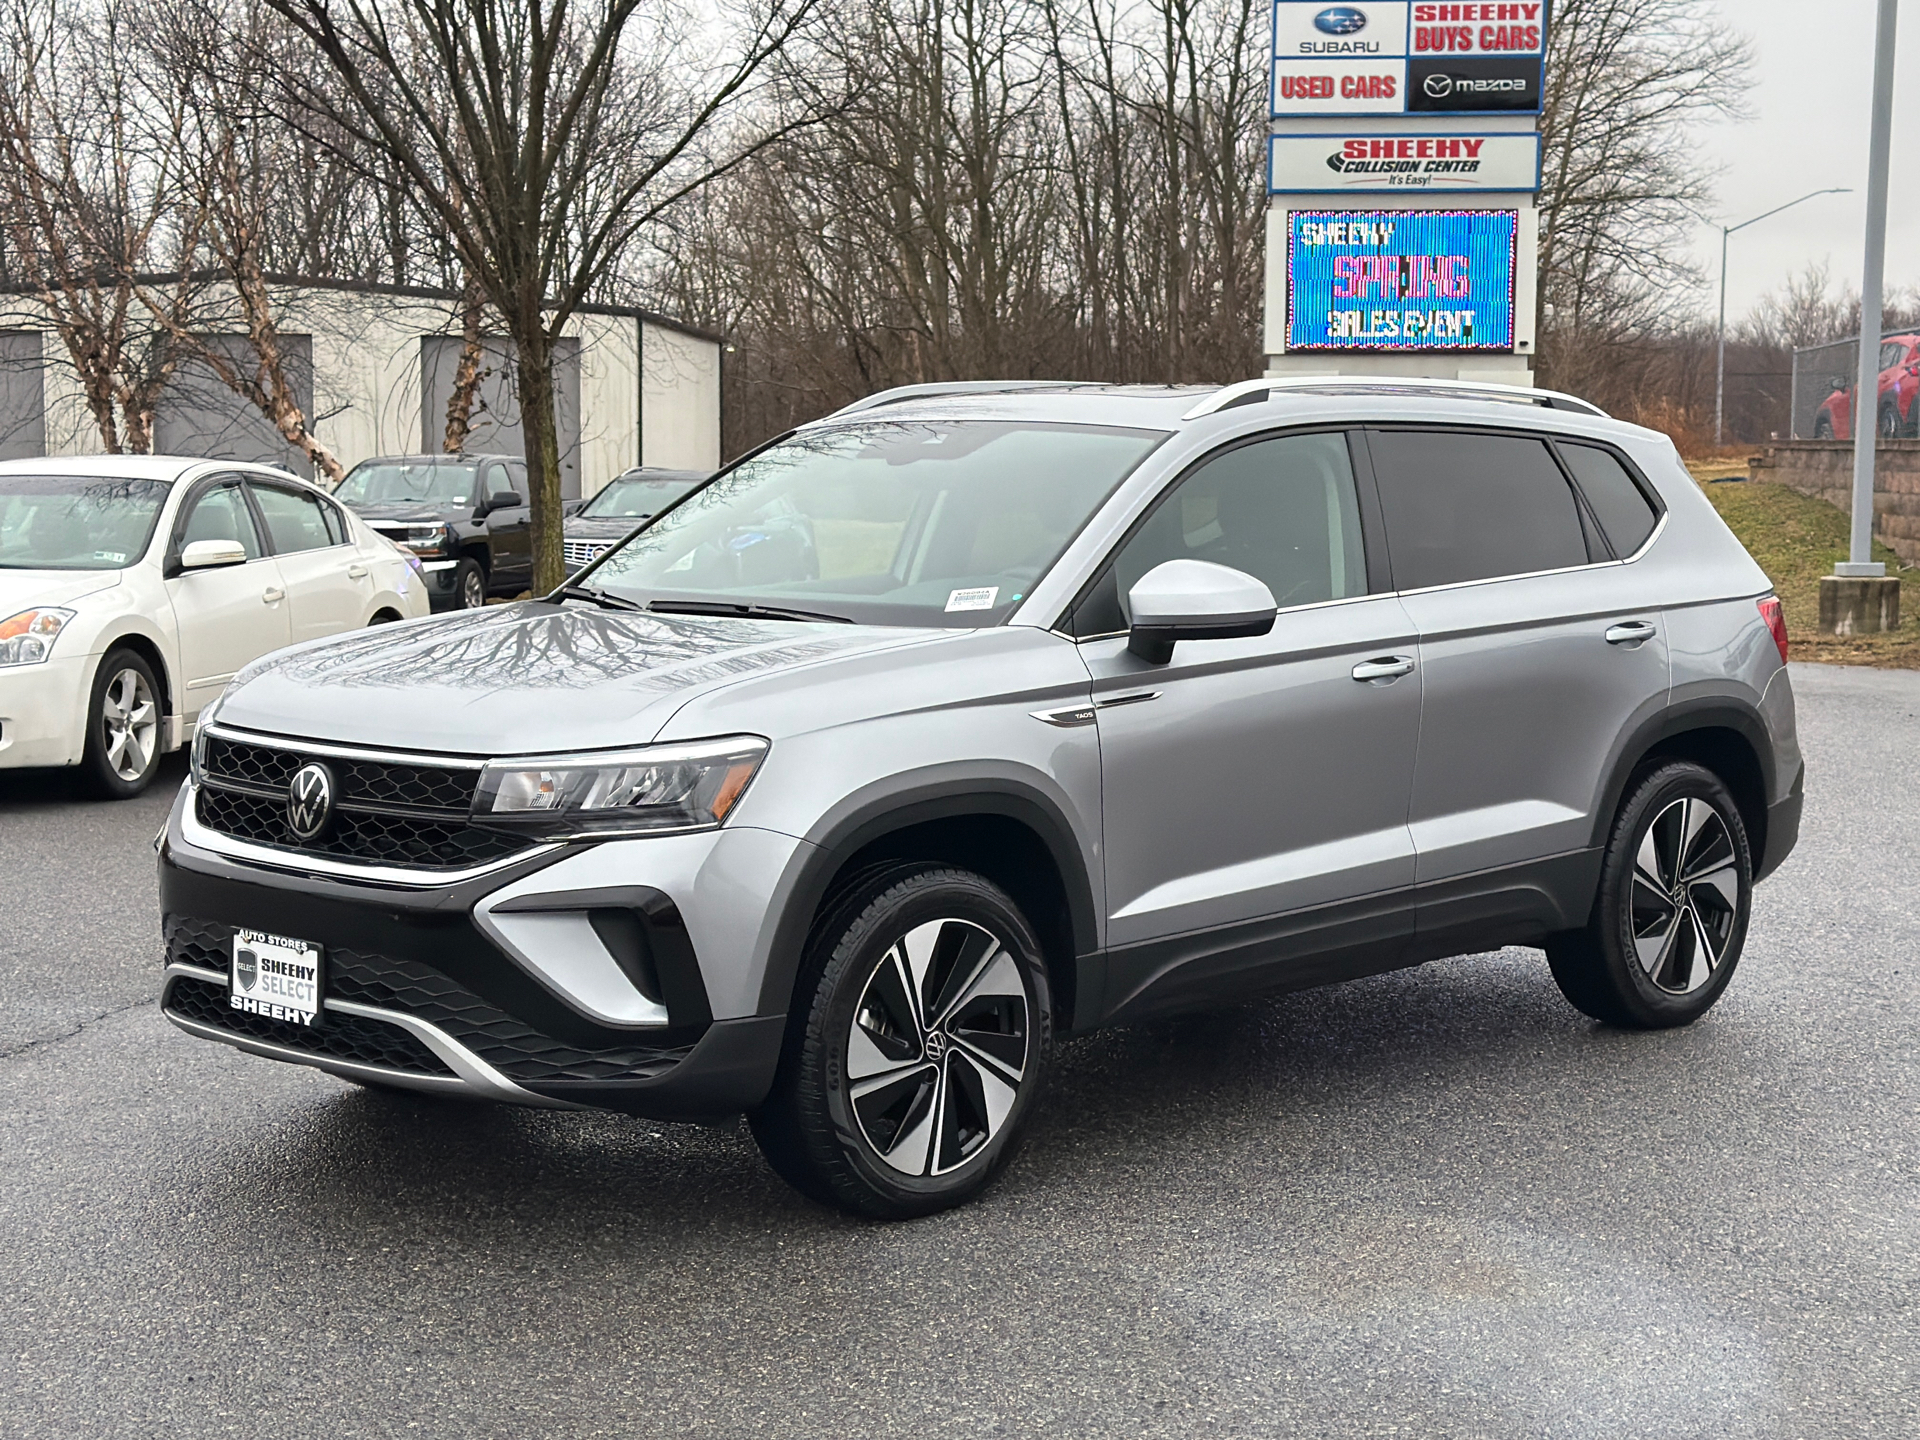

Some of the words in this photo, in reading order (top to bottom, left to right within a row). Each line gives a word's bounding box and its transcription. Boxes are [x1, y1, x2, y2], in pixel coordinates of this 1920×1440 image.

[1414, 3, 1541, 22] SHEEHY
[1299, 41, 1380, 53] SUBARU
[1415, 26, 1473, 51] BUYS
[1479, 25, 1540, 50] CARS
[1281, 76, 1335, 99] USED
[1341, 75, 1397, 99] CARS
[1343, 139, 1485, 159] SHEEHY
[1343, 160, 1420, 173] COLLISION
[1424, 160, 1481, 173] CENTER
[1388, 175, 1403, 185] It's
[1405, 175, 1432, 186] Easy!
[1301, 222, 1395, 245] SHEEHY
[1334, 255, 1469, 297] SPRING
[1075, 711, 1094, 719] TAOS
[238, 929, 265, 942] AUTO
[267, 935, 308, 951] STORES
[237, 962, 256, 973] SELECT
[261, 958, 315, 981] SHEEHY
[262, 974, 315, 1002] SELECT
[230, 995, 315, 1026] SHEEHY
